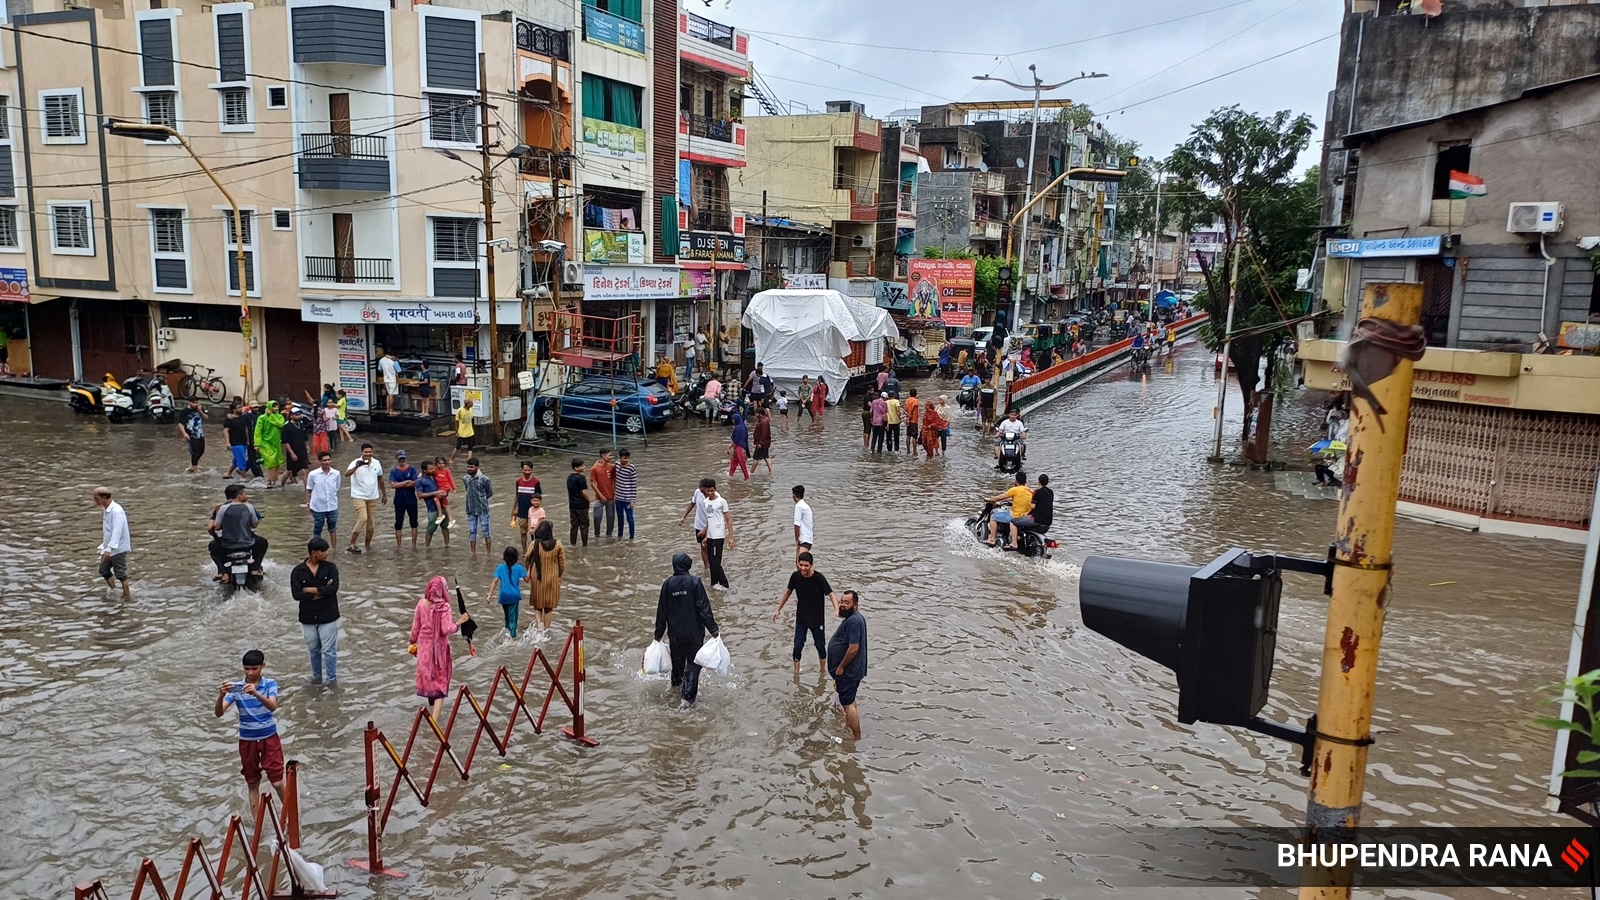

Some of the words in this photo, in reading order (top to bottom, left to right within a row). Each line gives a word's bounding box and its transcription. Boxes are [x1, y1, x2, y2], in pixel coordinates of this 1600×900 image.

[697, 238, 706, 248] DJ
[707, 238, 729, 250] SEEN
[942, 288, 954, 296] 04
[457, 309, 476, 319] હાઉ
[1413, 371, 1477, 386] LLERS
